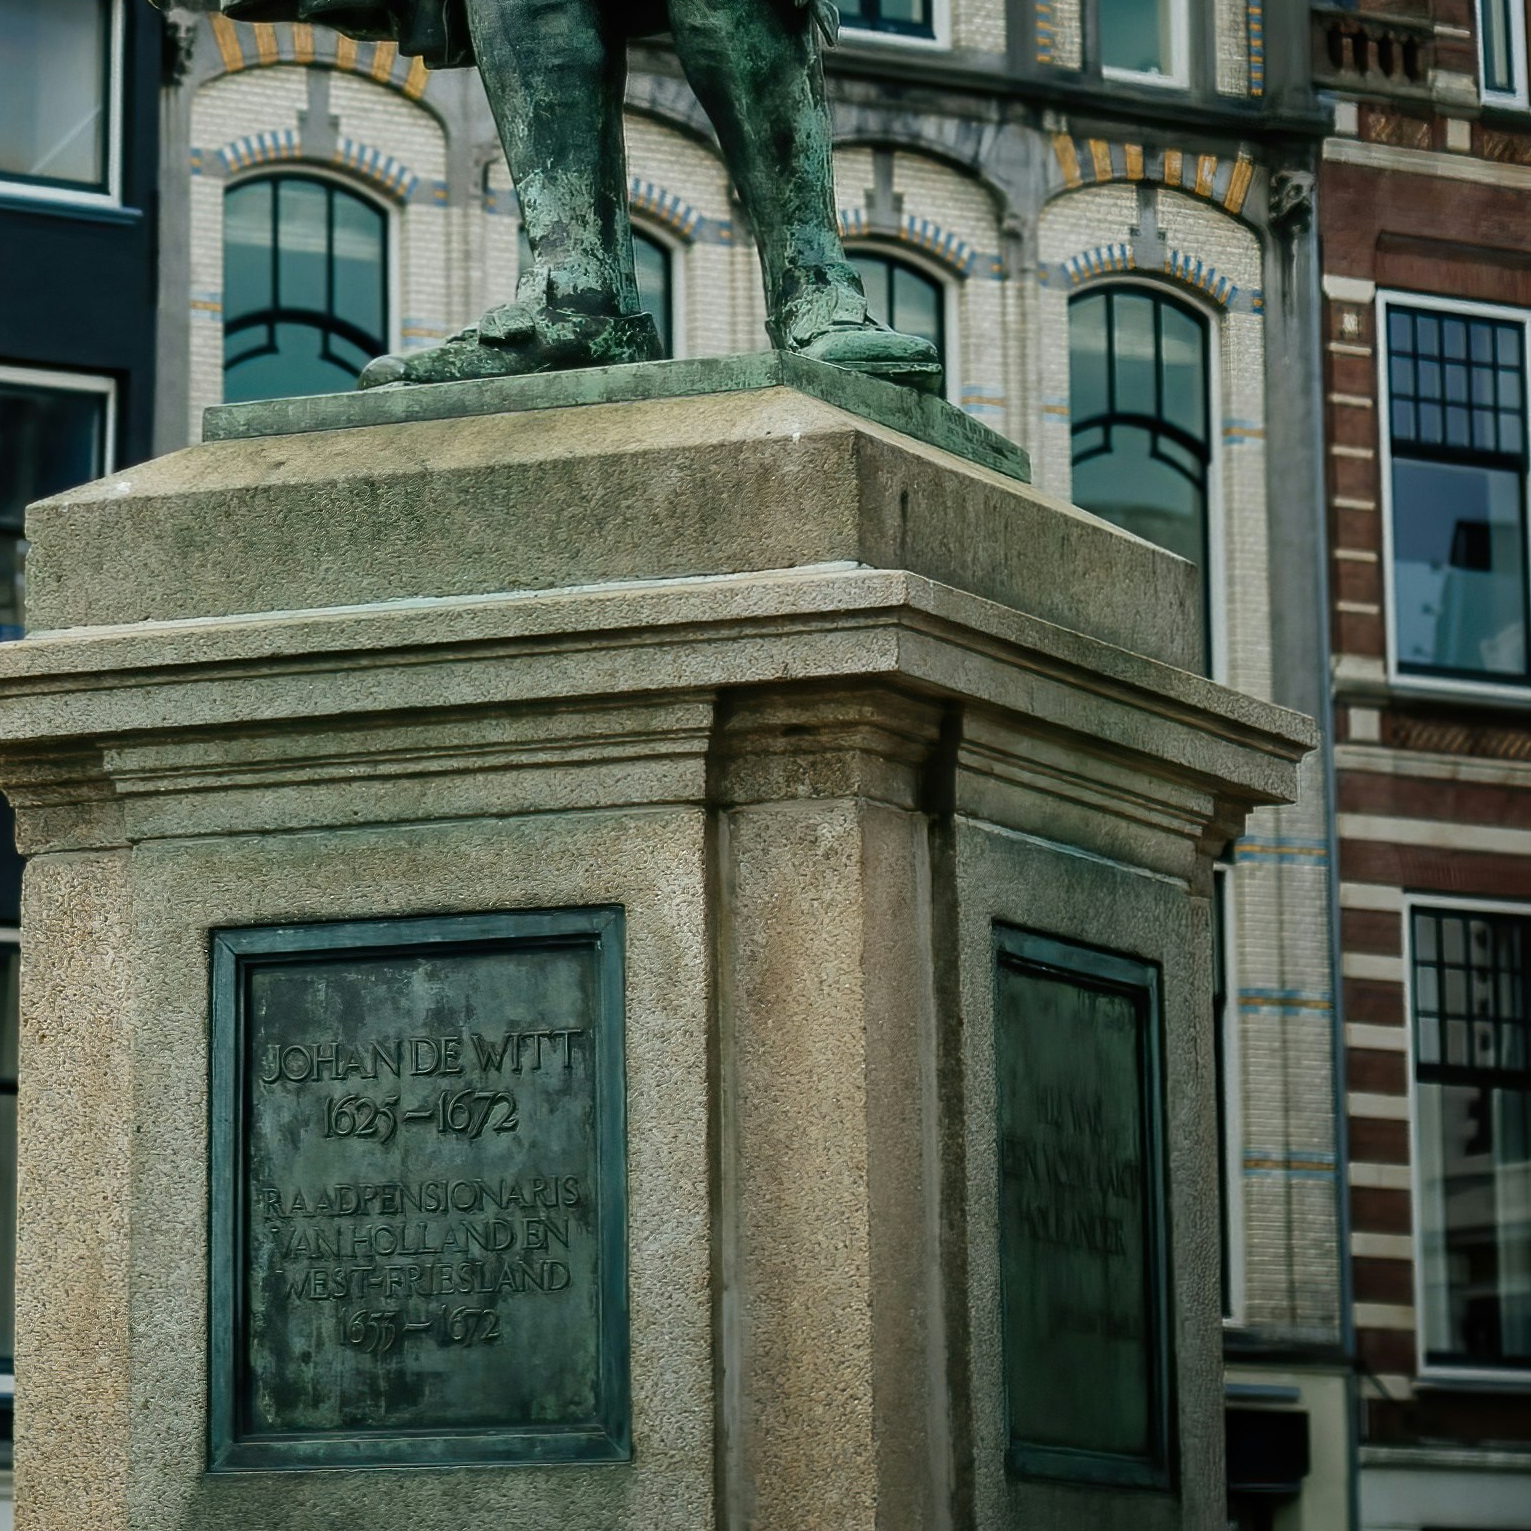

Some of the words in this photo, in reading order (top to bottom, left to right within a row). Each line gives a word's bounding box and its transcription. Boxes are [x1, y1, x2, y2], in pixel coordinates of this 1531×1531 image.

[260, 1038, 402, 1084] JOHAN
[408, 1036, 464, 1077] DE
[470, 1026, 583, 1075] WITT
[323, 1093, 401, 1145] 1625
[437, 1088, 519, 1140] 1672
[261, 1174, 582, 1218] RAADPENSIONARIS
[269, 1224, 342, 1260] VAN
[348, 1219, 518, 1258] HOLLAND
[522, 1217, 570, 1252] EN
[277, 1258, 571, 1301] WEST-FRIESLAND
[440, 1303, 502, 1348] 1672
